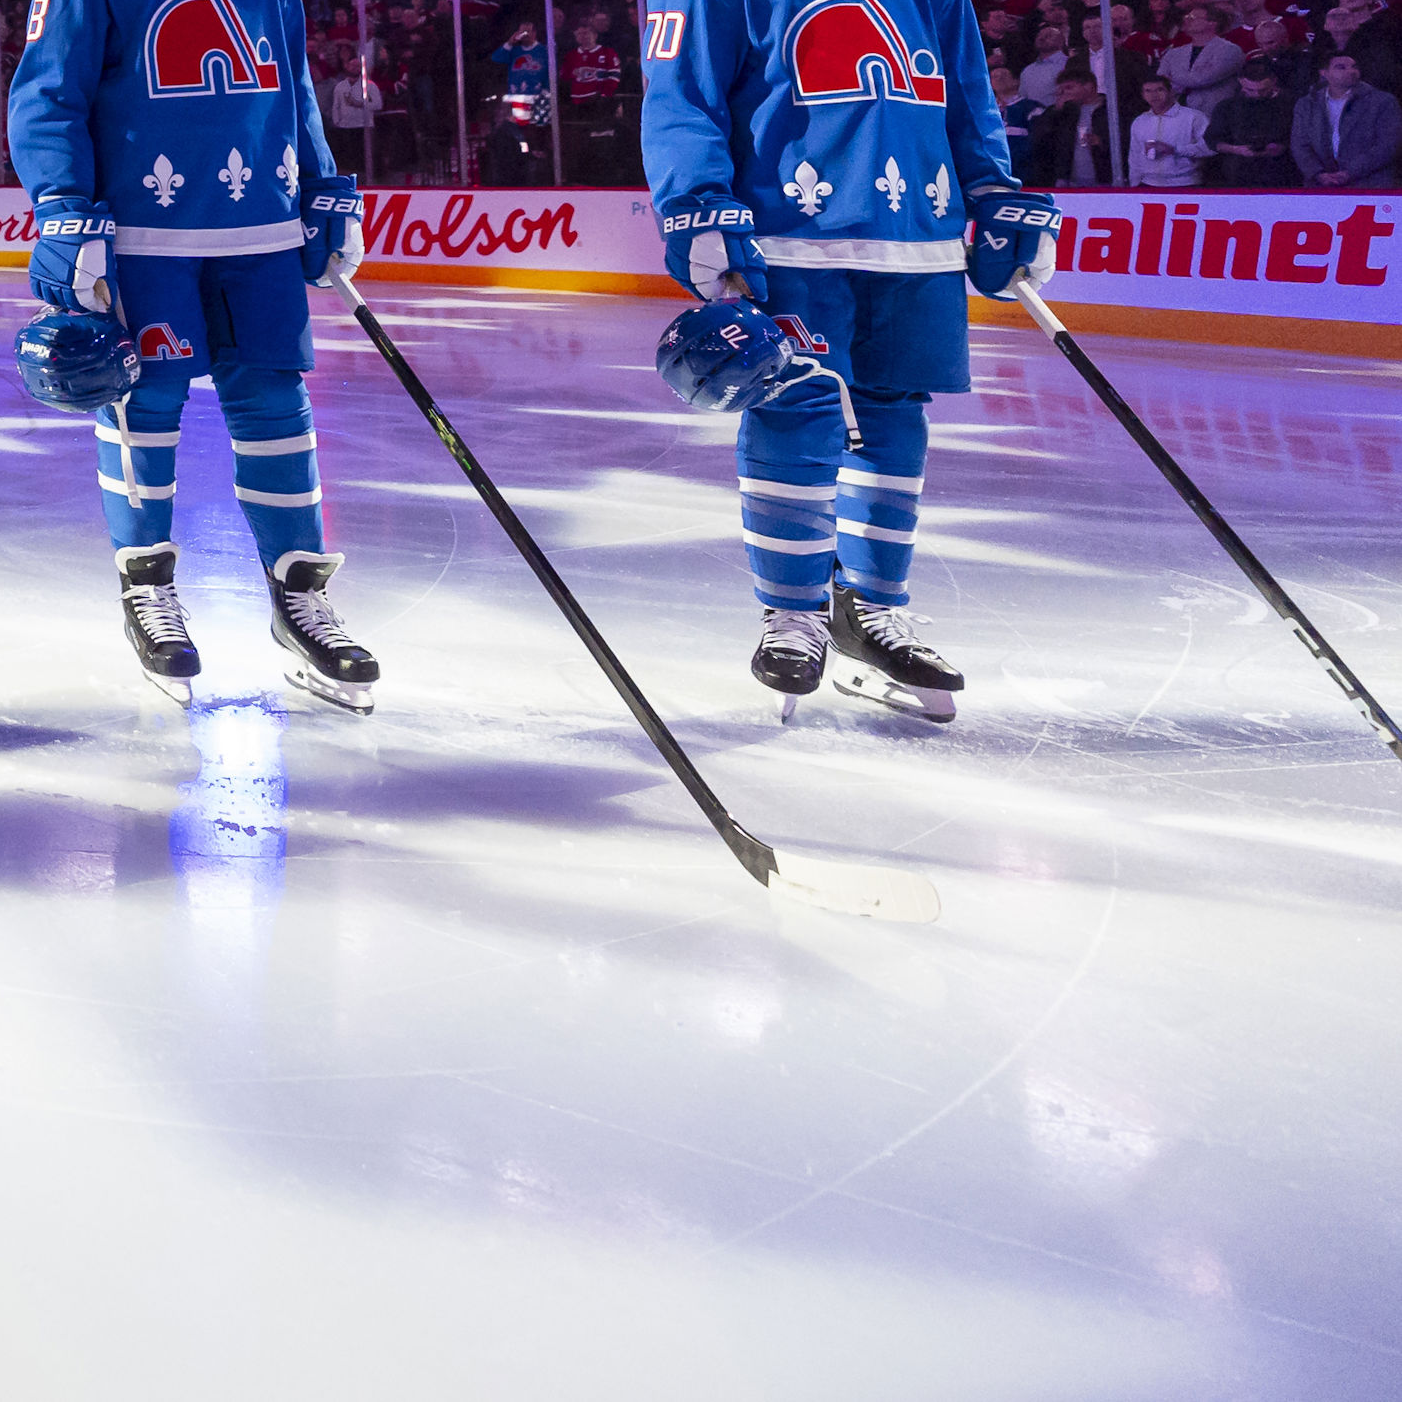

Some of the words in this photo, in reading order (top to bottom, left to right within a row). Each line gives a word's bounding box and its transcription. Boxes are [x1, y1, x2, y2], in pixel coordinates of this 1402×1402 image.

[646, 11, 686, 61] 70
[362, 193, 578, 258] Molson
[663, 209, 755, 234] BAUER
[719, 323, 749, 350] 70
